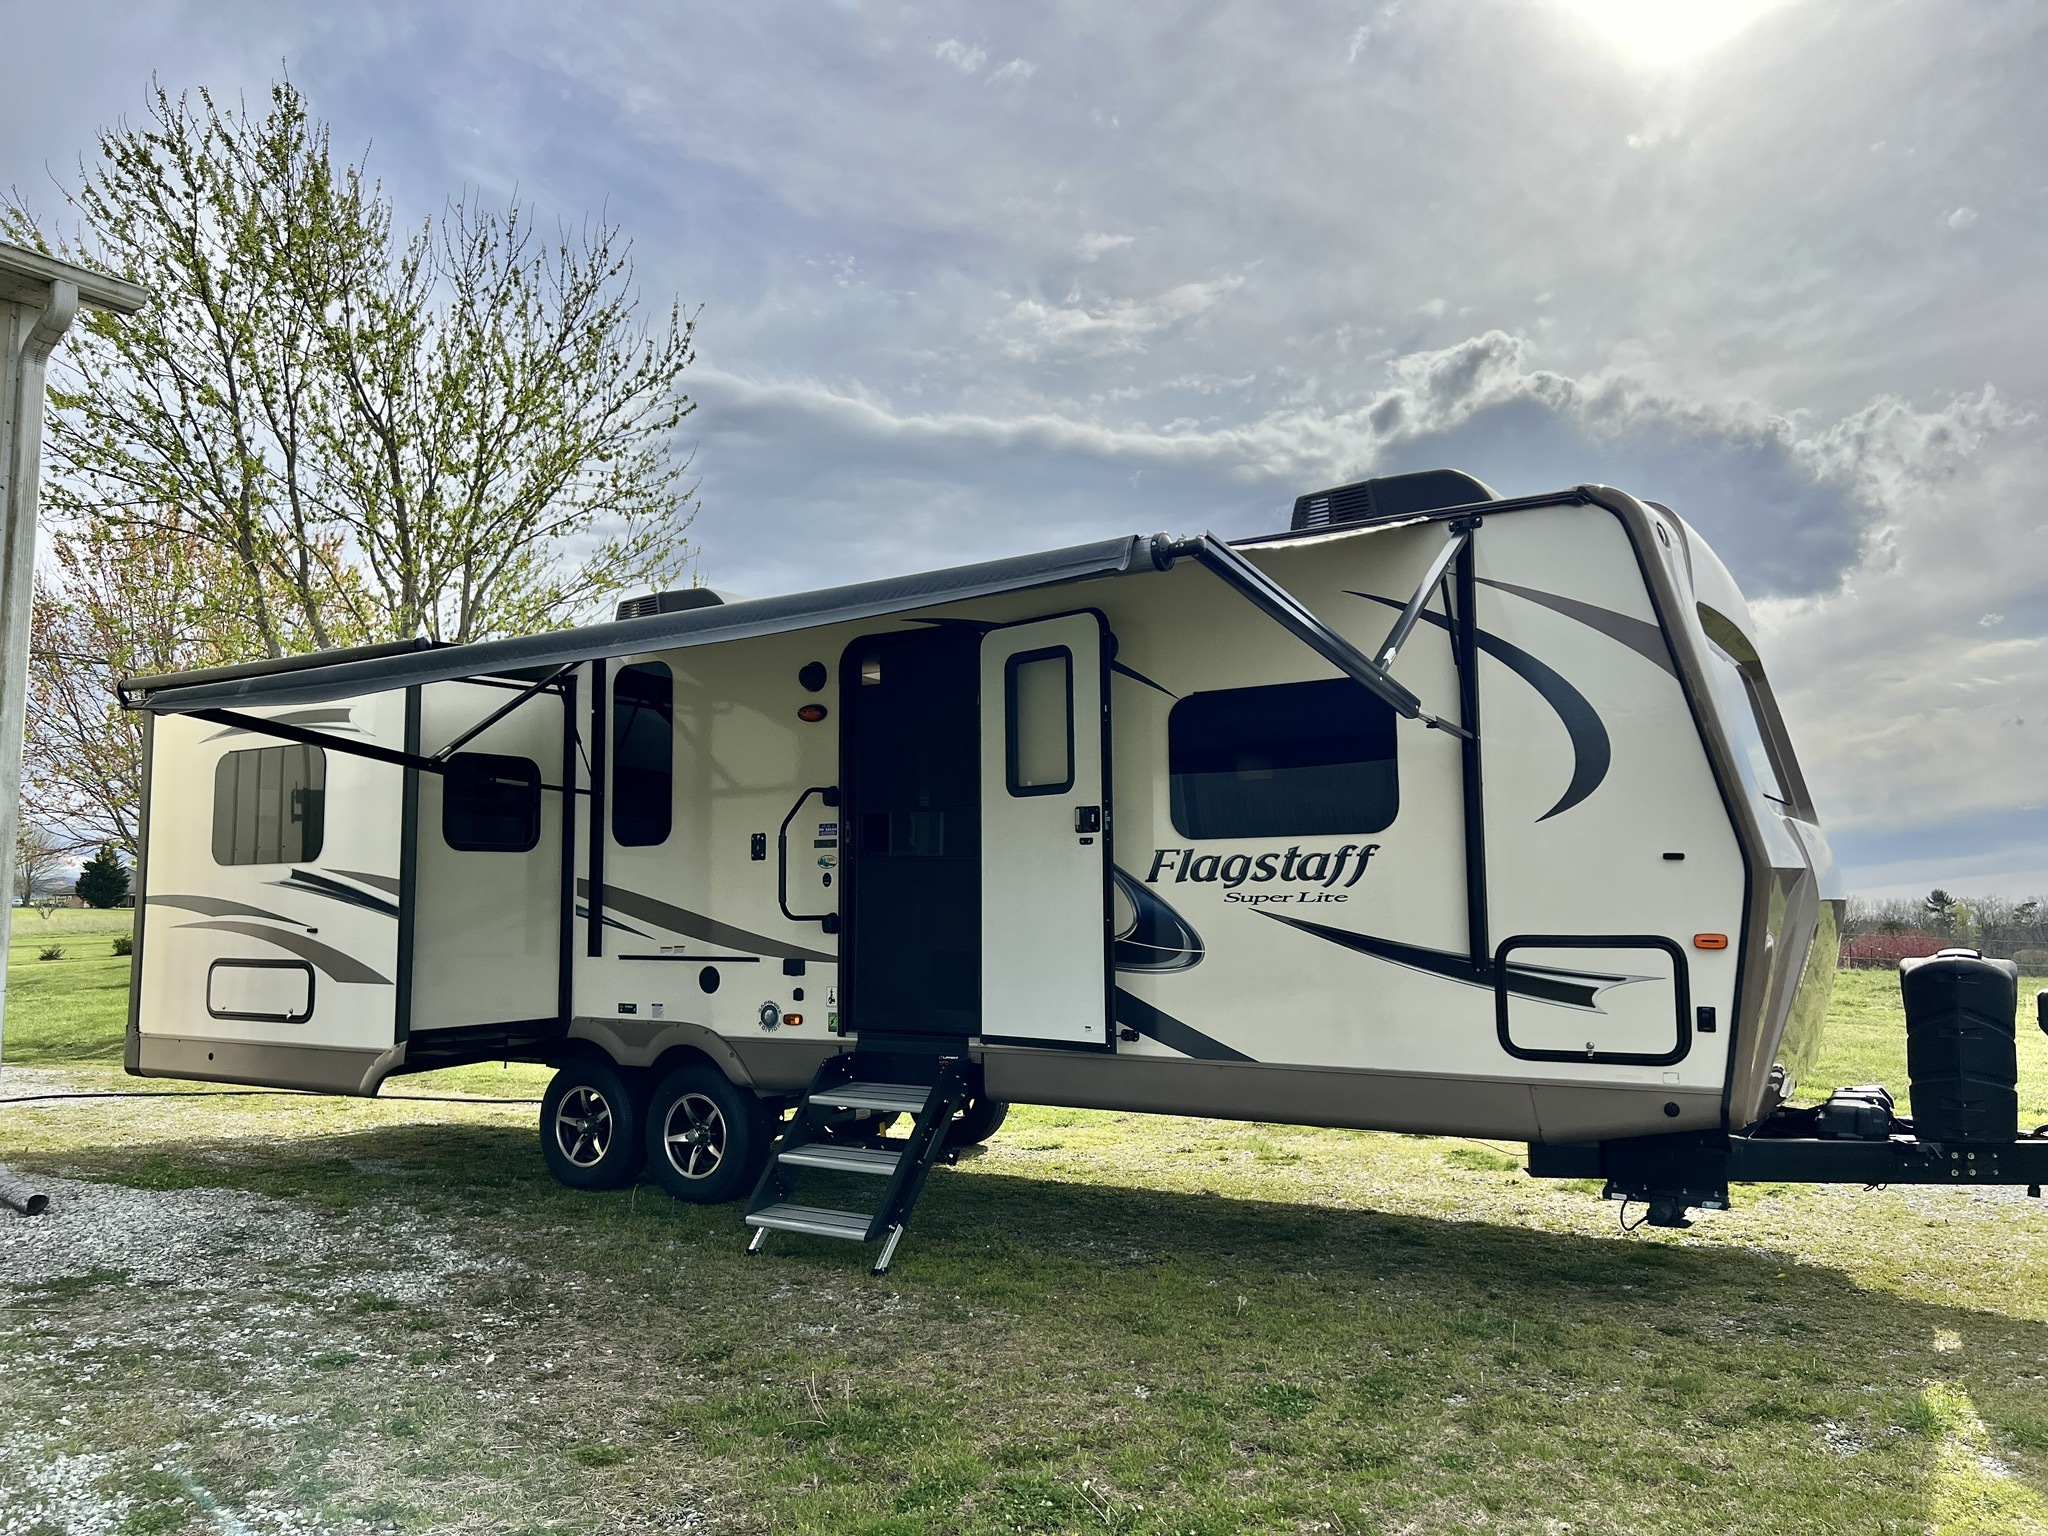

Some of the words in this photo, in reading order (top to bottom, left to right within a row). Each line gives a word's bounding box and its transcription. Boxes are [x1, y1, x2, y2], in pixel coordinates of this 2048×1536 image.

[1145, 844, 1381, 889] Flagstaff
[1223, 892, 1294, 905] Super
[1296, 891, 1349, 903] Lite
